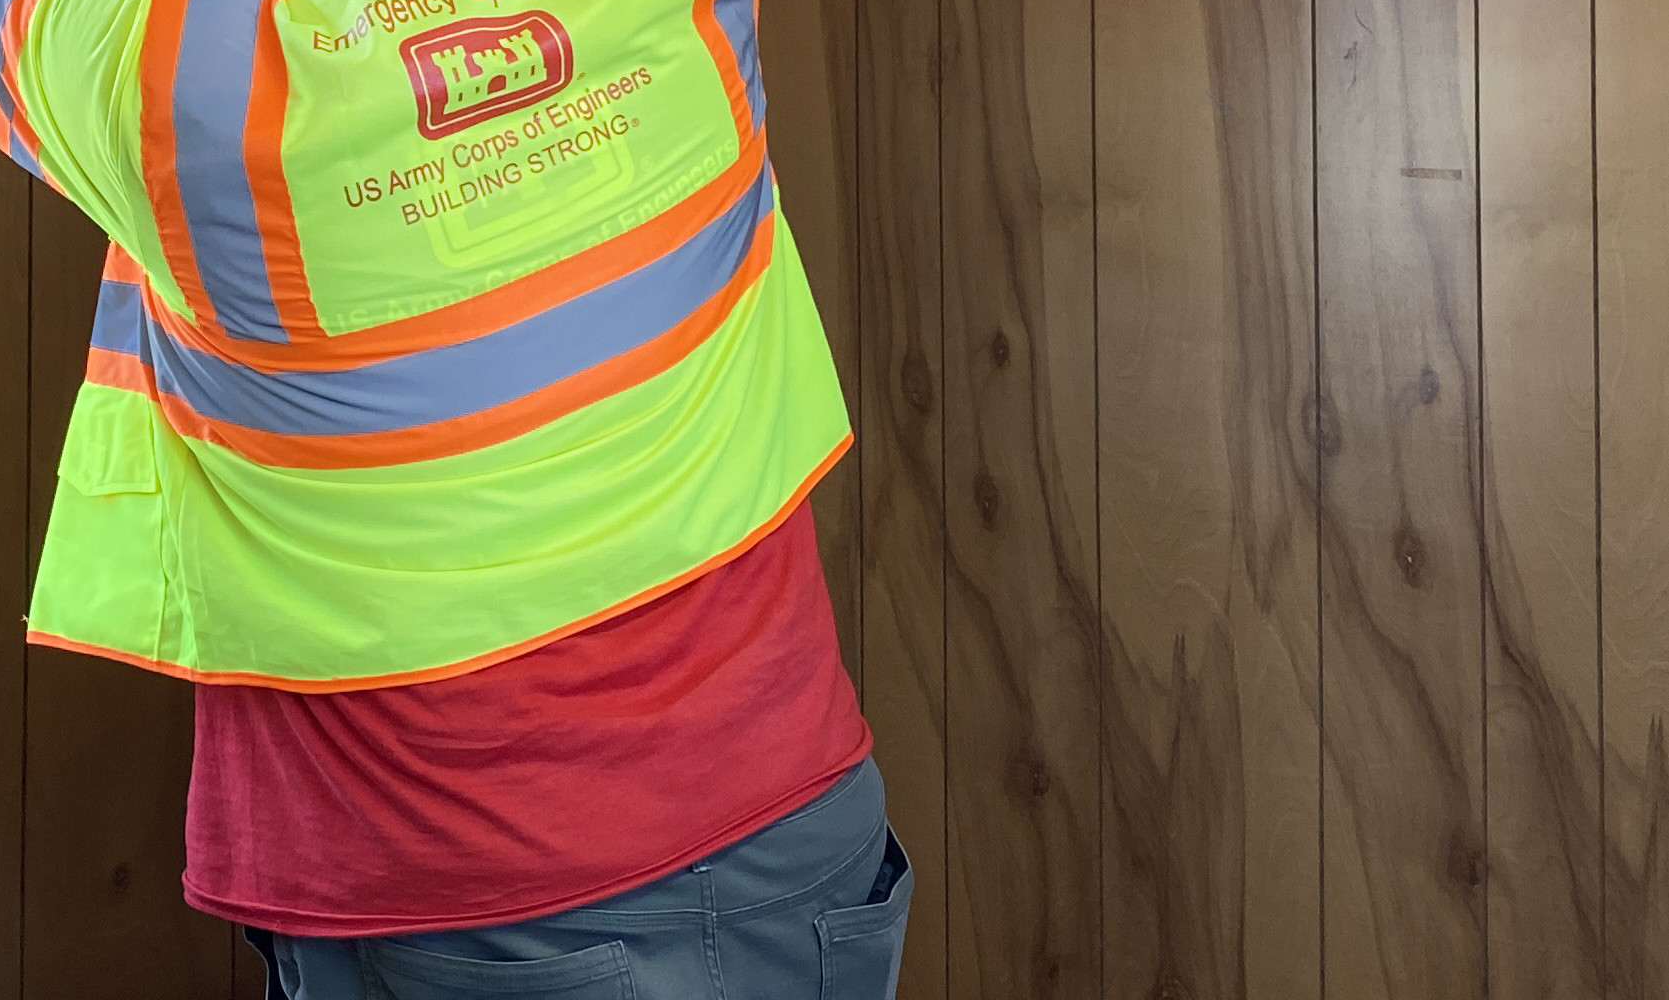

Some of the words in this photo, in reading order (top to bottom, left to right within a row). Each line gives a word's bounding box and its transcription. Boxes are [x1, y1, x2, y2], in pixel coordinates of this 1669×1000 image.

[343, 177, 383, 207] US
[389, 156, 445, 196] Army
[451, 129, 519, 168] Corps
[522, 111, 545, 139] of
[544, 67, 652, 129] Engineers
[400, 162, 523, 225] BUILDING
